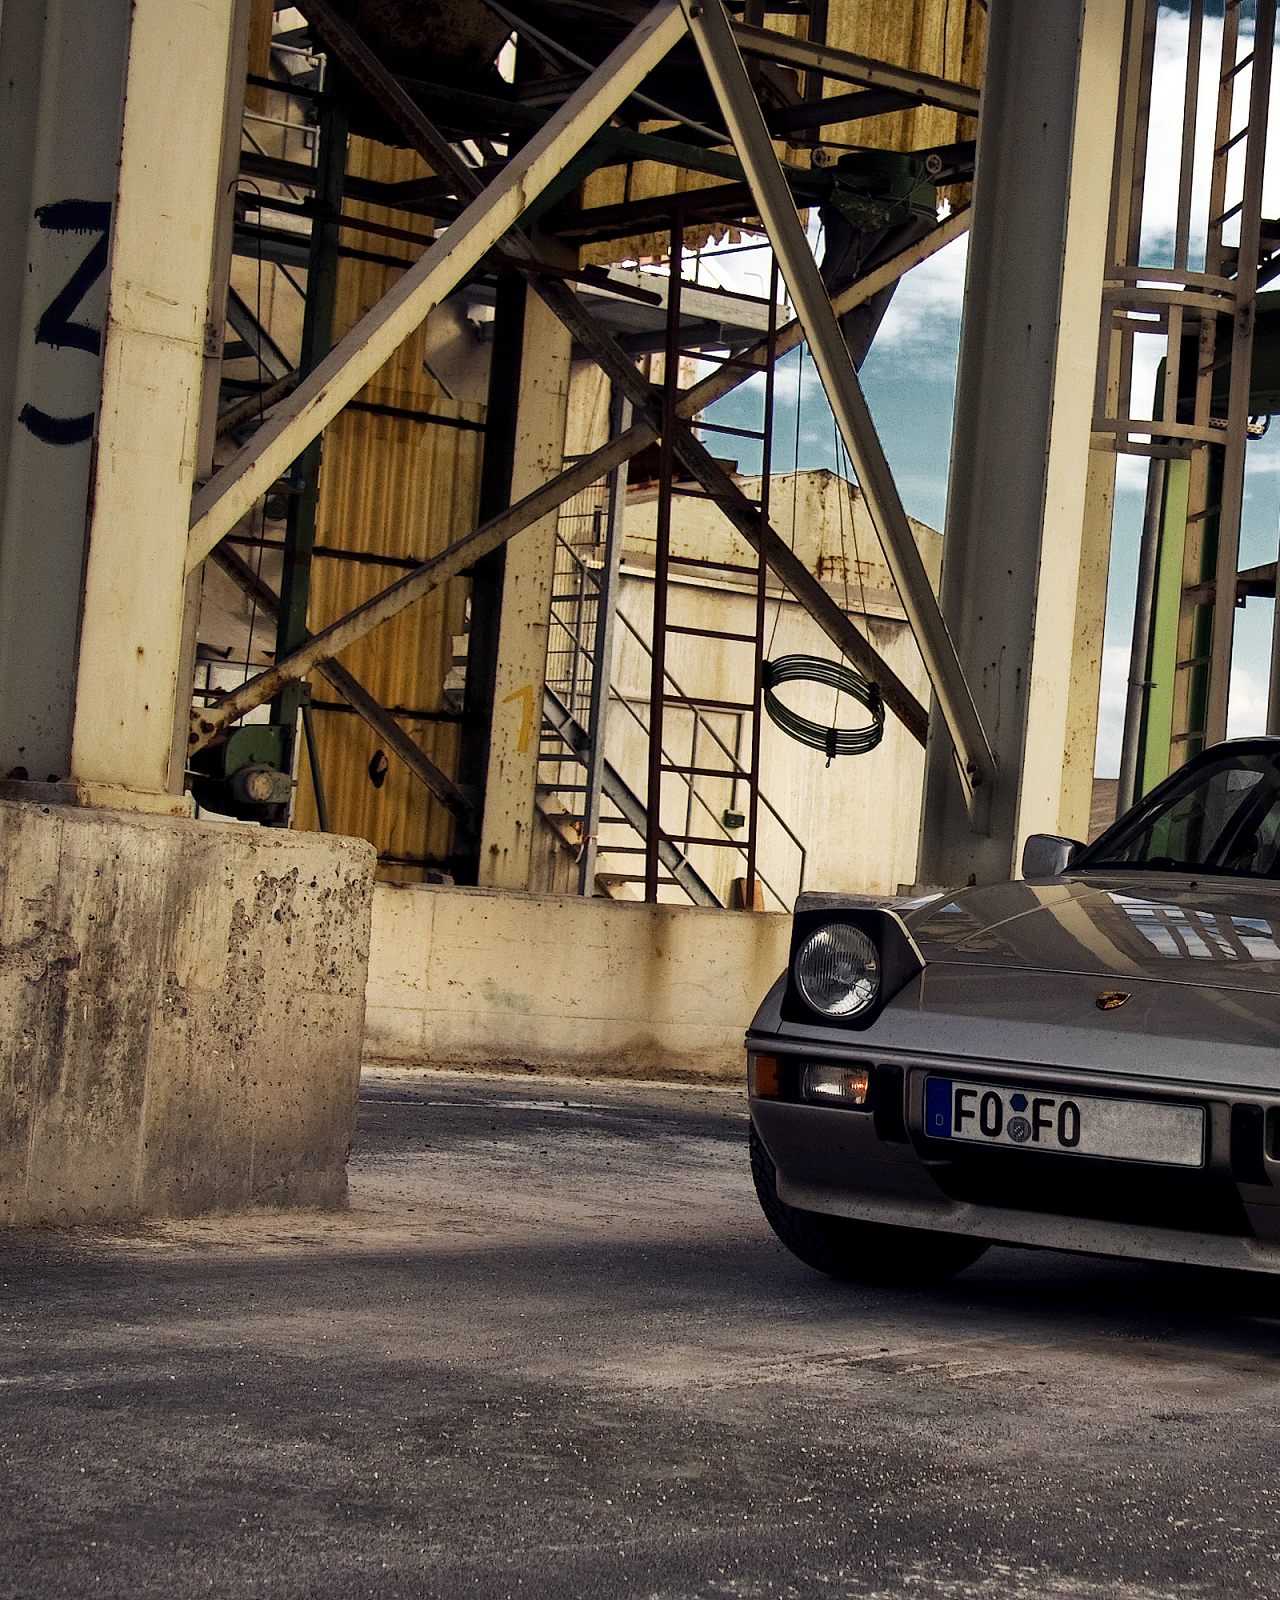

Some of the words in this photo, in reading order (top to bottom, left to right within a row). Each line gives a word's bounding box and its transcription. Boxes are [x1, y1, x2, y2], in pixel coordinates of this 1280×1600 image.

[936, 1113, 944, 1126] D
[954, 1088, 1003, 1137] FO
[1032, 1098, 1081, 1148] FO
